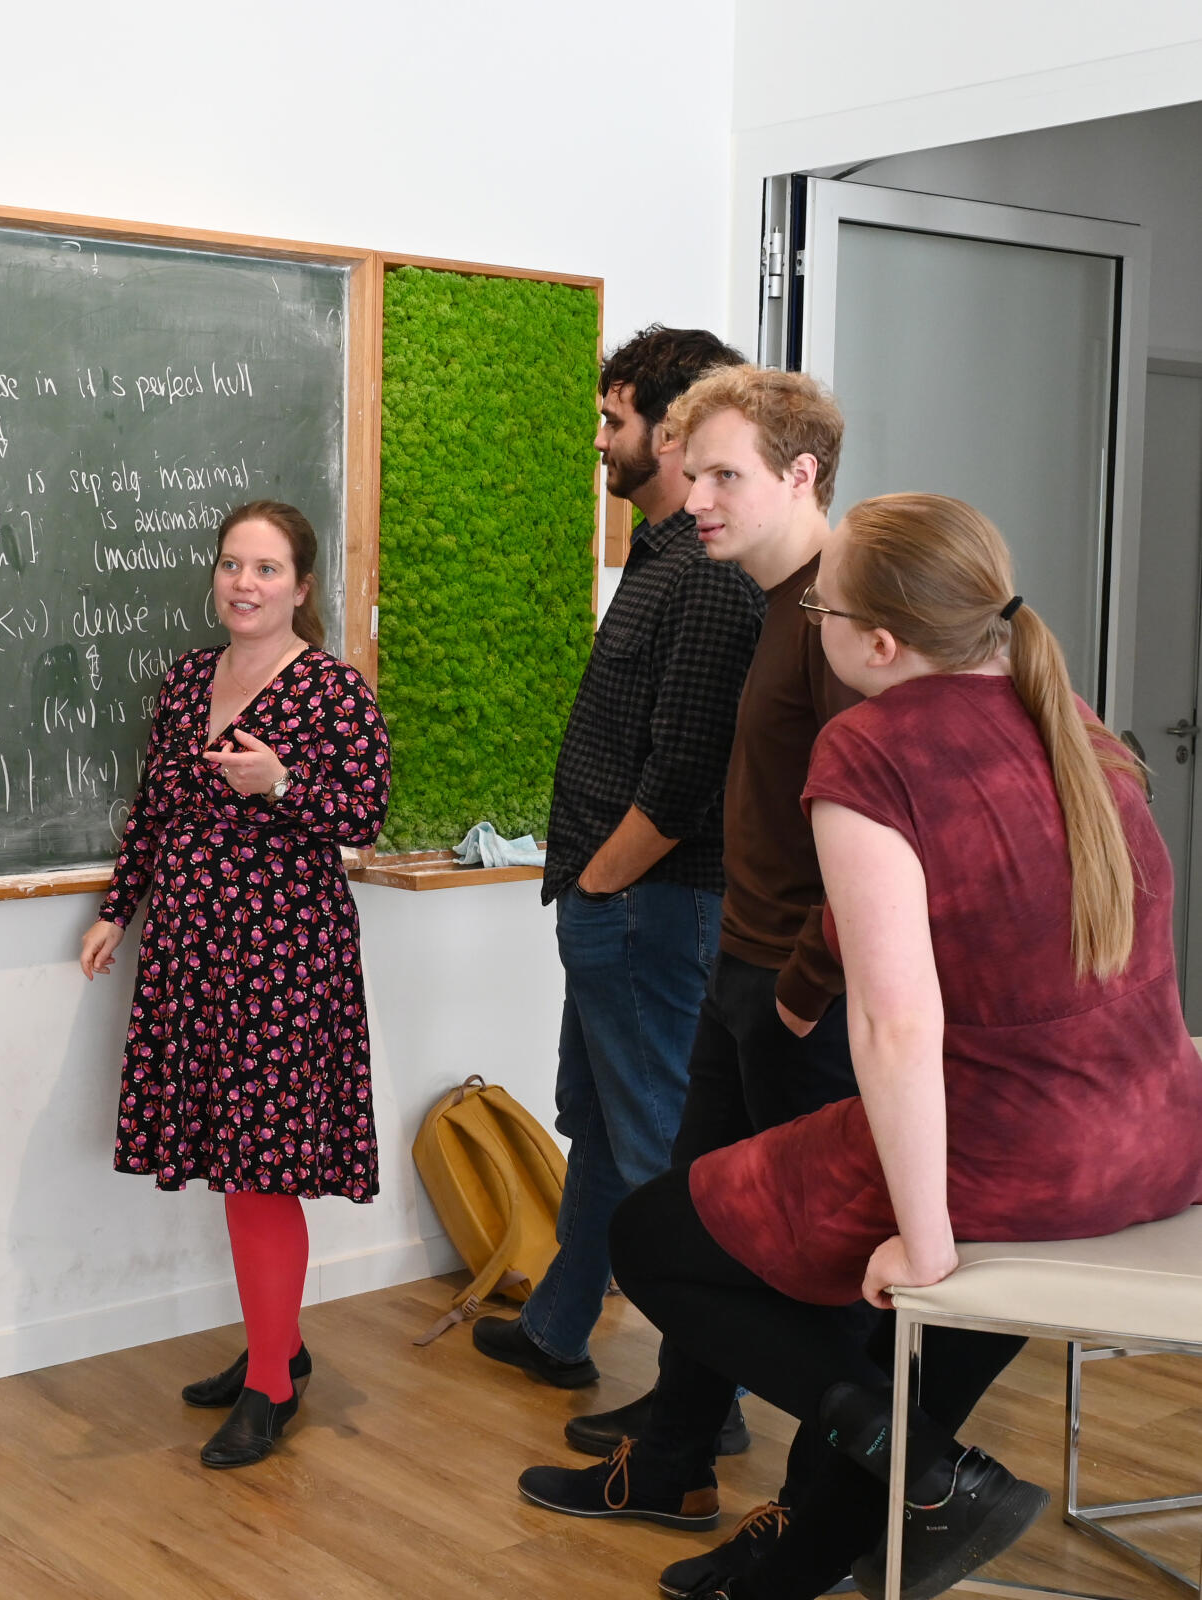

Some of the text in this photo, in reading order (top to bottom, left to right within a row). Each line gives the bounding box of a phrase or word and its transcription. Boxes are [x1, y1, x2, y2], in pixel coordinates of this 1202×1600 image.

[35, 370, 57, 397] in
[212, 361, 252, 398] hull
[72, 595, 149, 639] dense
[162, 603, 190, 633] in
